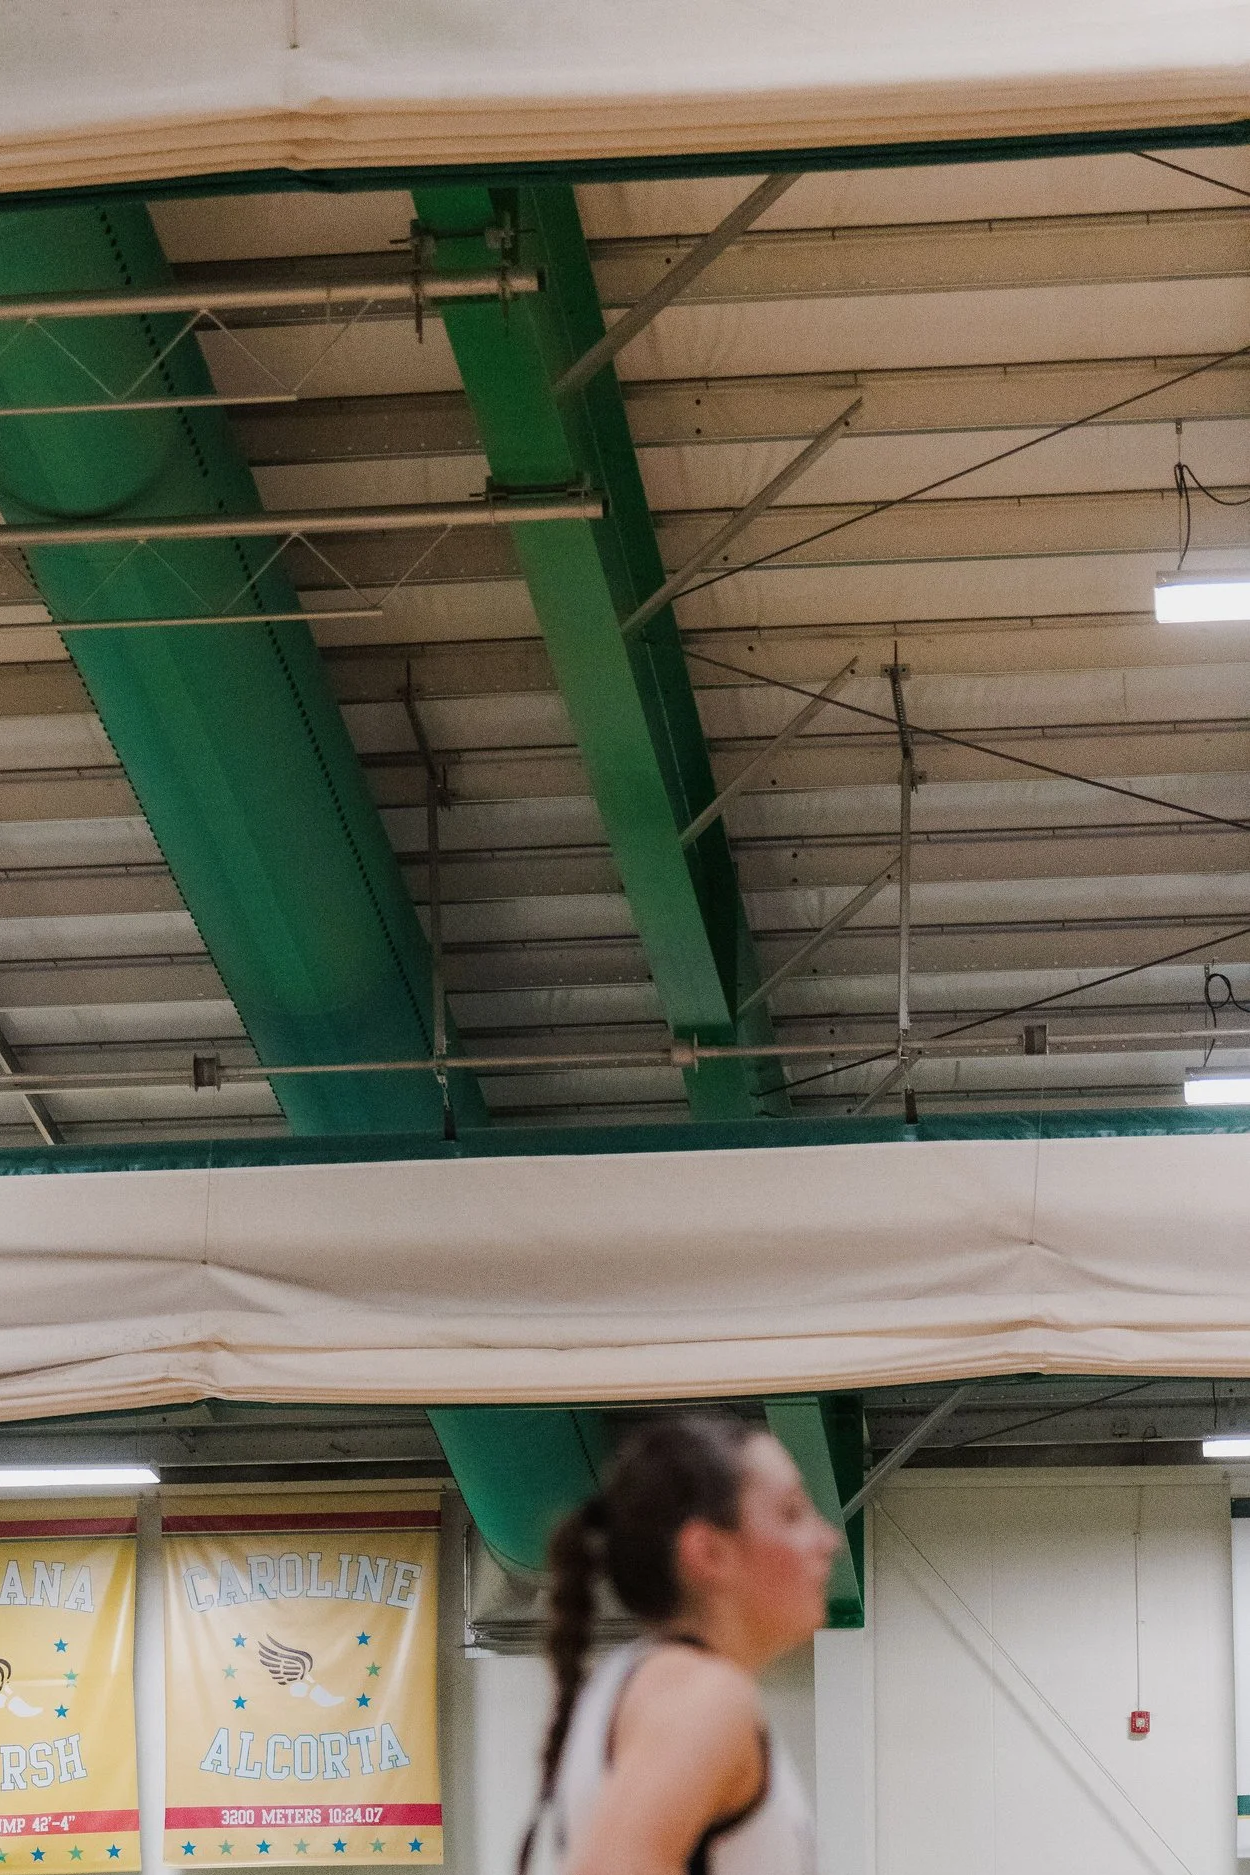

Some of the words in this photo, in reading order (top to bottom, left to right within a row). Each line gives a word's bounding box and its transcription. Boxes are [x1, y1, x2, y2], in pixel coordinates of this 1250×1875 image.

[182, 1551, 423, 1614] CAROLINE
[199, 1722, 411, 1781] ALCORTA
[220, 1809, 255, 1826] 3200
[261, 1808, 321, 1825] METERS
[328, 1807, 383, 1824] 10:24.07
